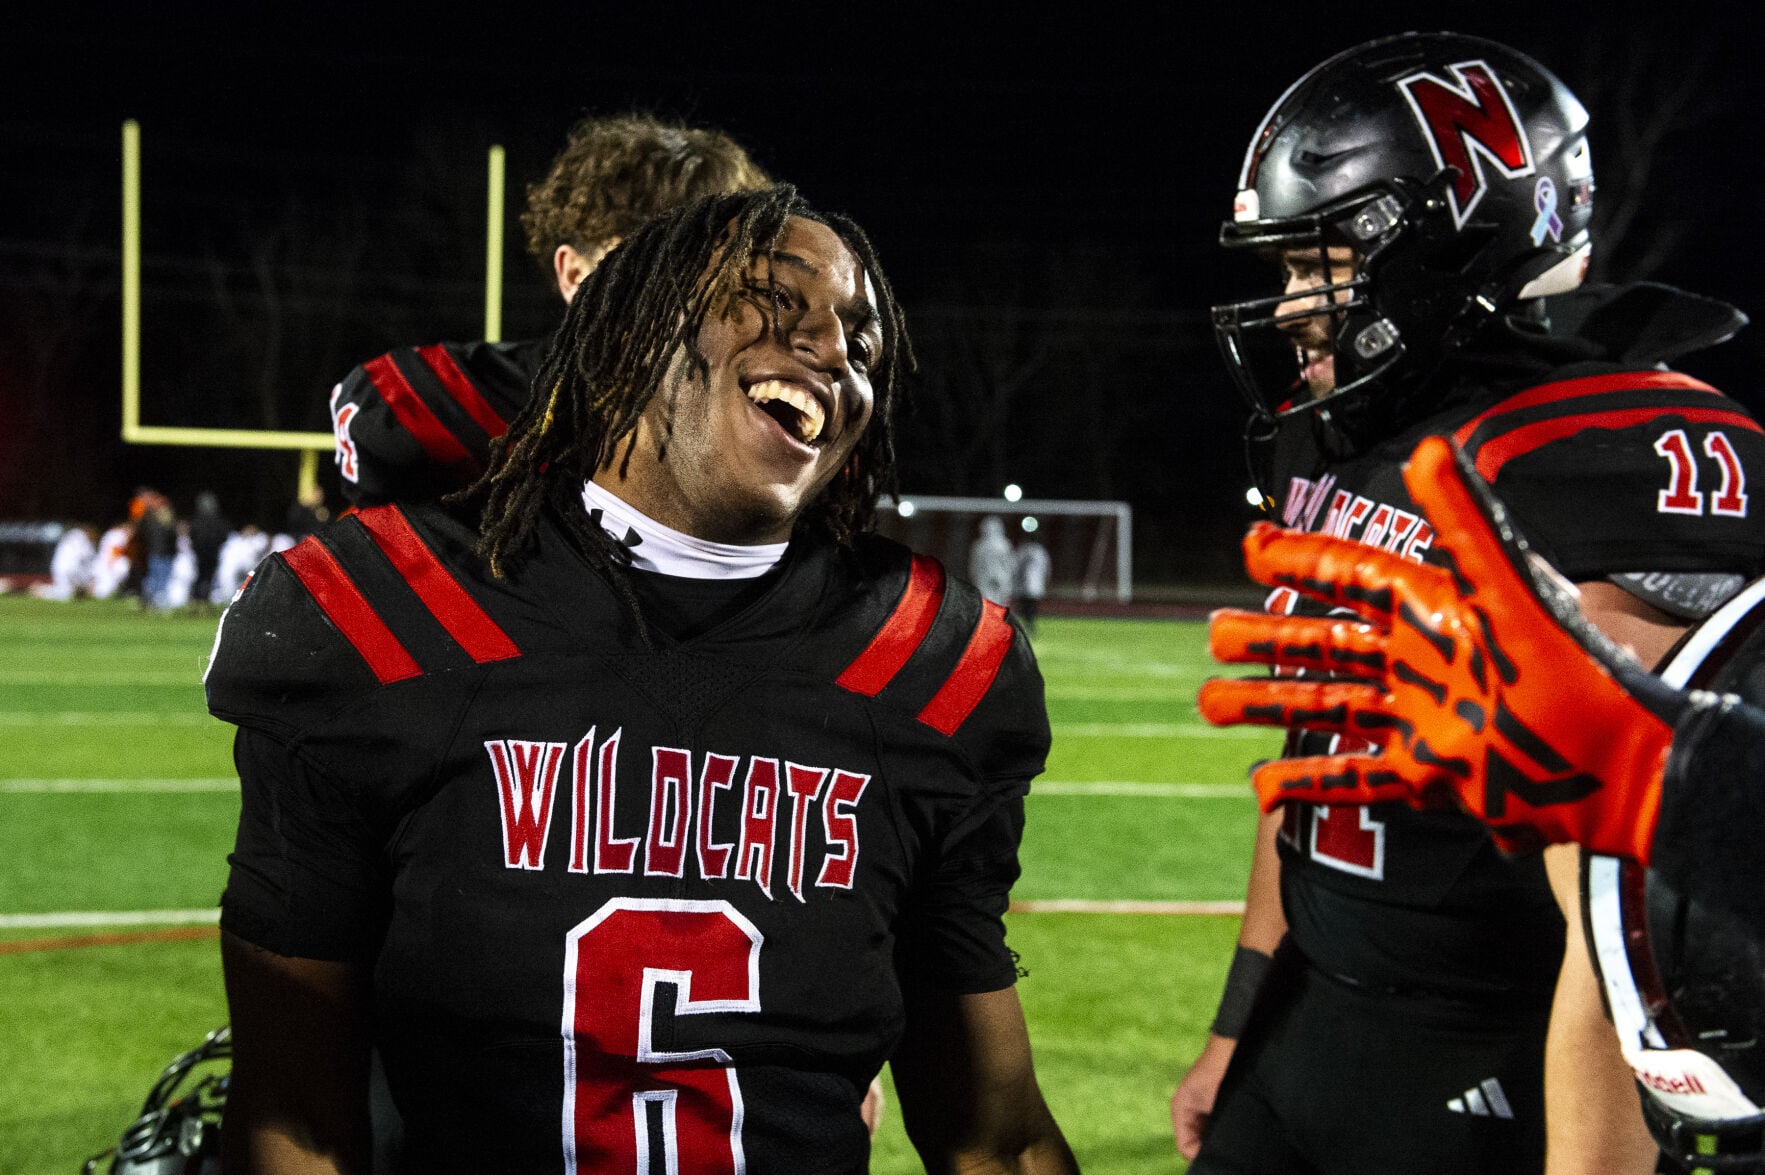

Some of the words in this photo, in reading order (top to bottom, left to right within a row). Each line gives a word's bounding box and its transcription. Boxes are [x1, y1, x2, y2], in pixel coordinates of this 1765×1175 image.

[1397, 59, 1536, 231] N
[1654, 429, 1748, 518] 11
[484, 725, 872, 904] WILDCATS
[561, 897, 765, 1175] 6
